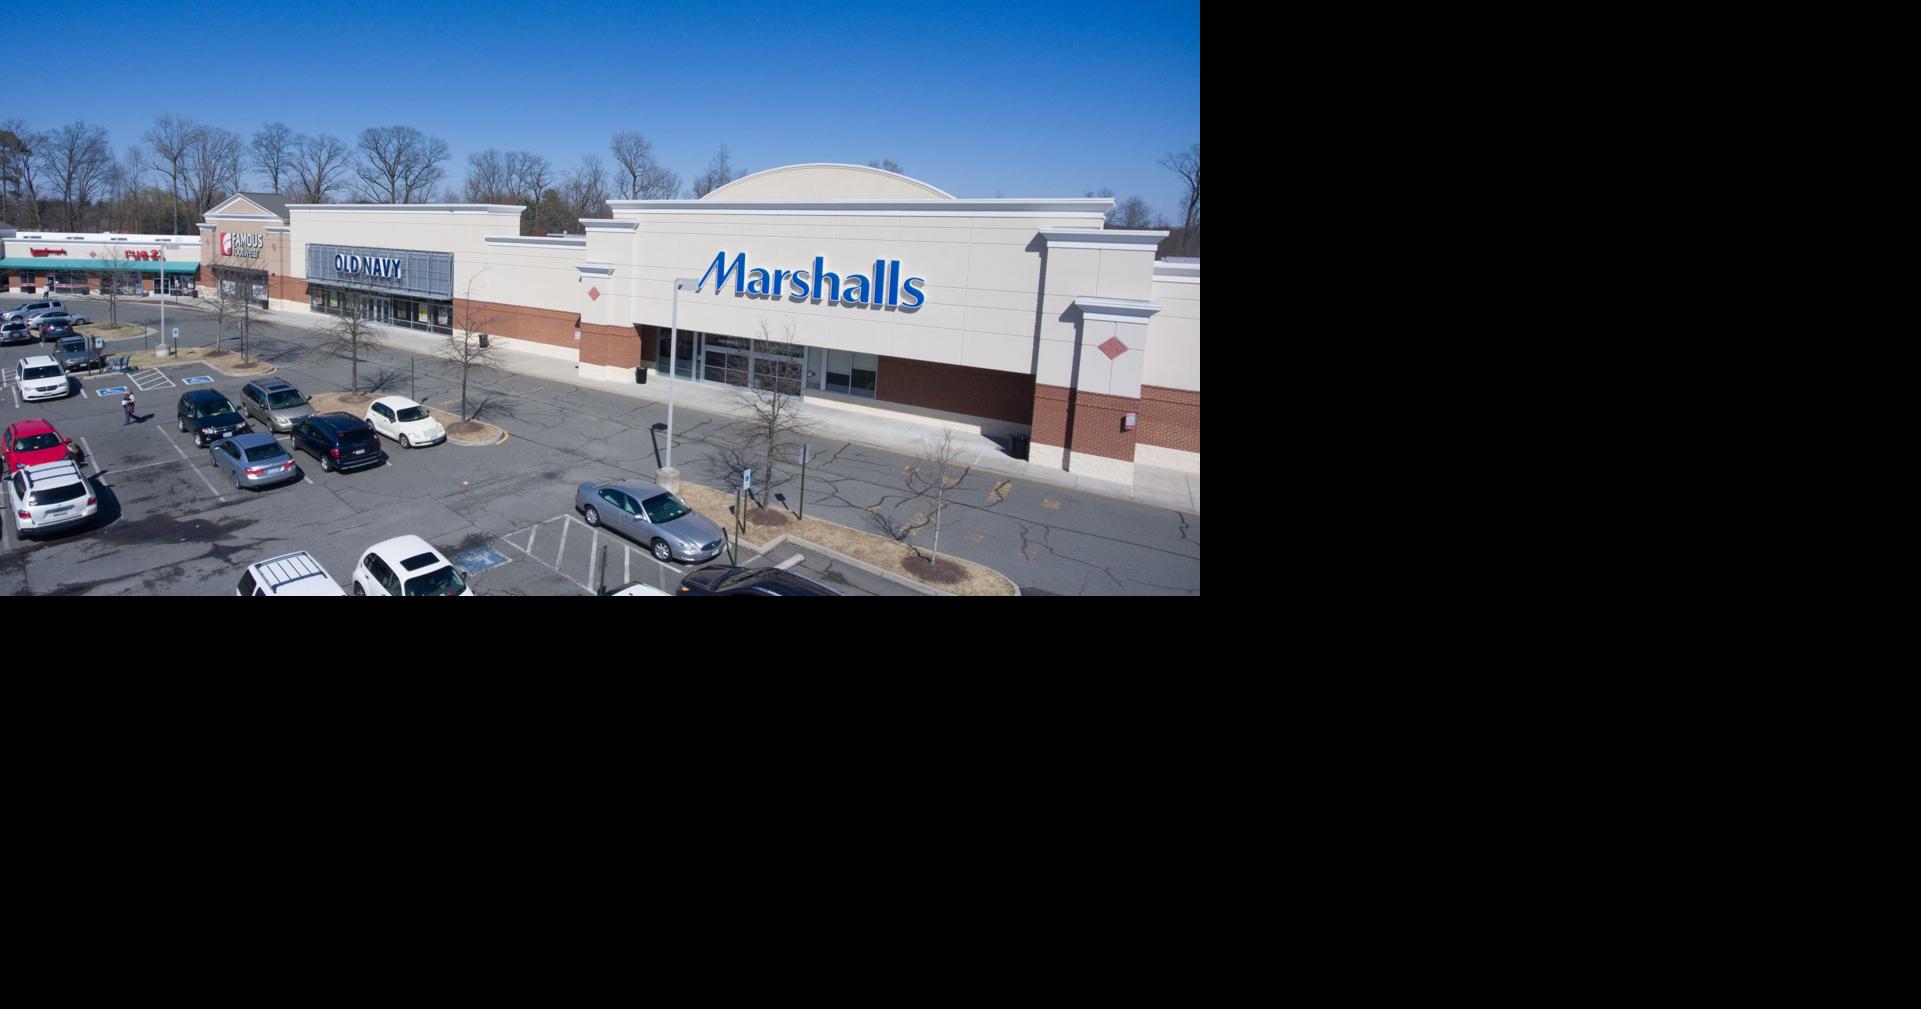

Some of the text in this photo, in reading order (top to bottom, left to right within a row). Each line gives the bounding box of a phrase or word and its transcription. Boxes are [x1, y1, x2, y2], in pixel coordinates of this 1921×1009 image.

[233, 232, 263, 248] FAMOUS
[335, 254, 401, 278] OLD NAVY
[698, 251, 925, 309] Marshalls
